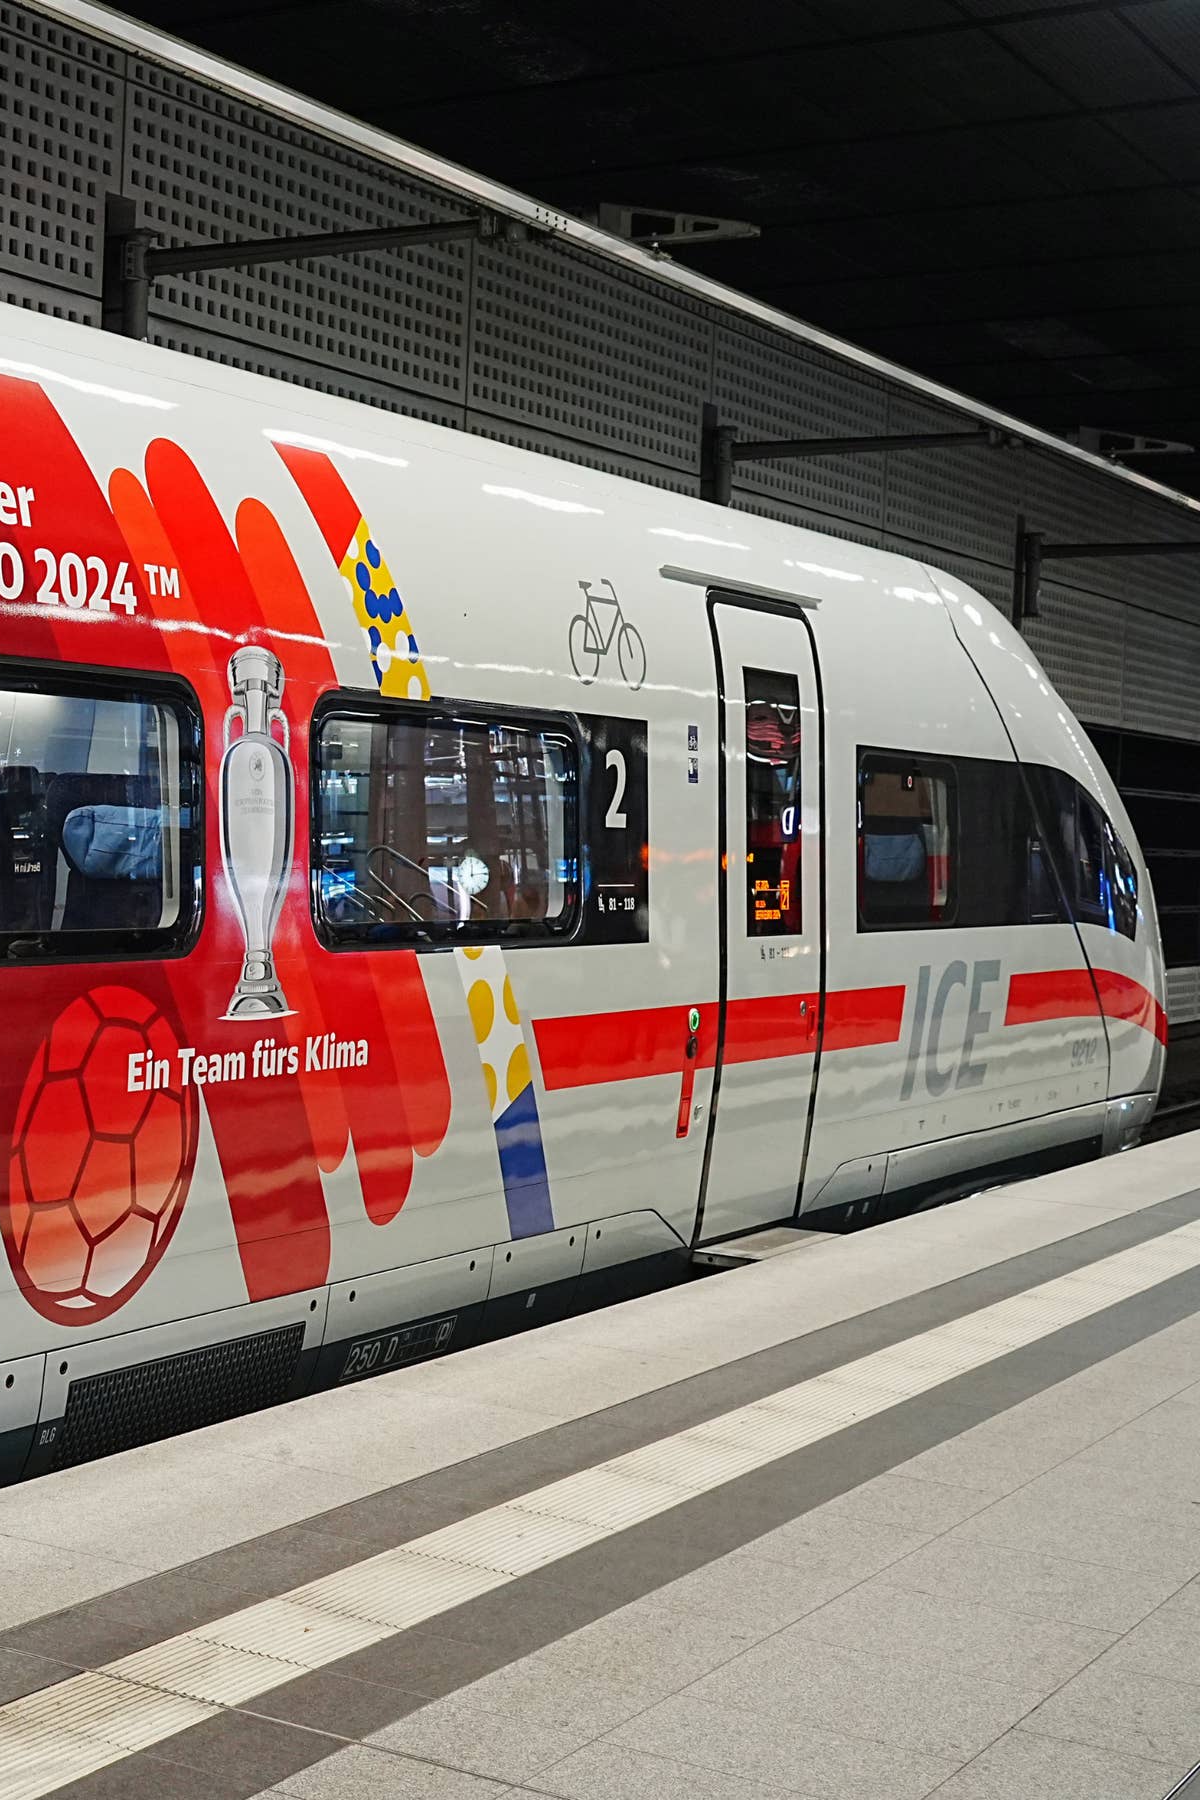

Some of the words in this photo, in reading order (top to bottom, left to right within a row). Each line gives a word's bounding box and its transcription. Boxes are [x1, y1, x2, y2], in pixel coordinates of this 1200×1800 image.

[34, 548, 138, 616] 2024
[605, 749, 627, 828] 2
[608, 897, 617, 911] 81
[127, 1049, 170, 1092] Ein
[177, 1047, 246, 1086] Team
[252, 1038, 299, 1078] fürs
[305, 1032, 368, 1072] Klima
[900, 960, 1001, 1101] ICE
[344, 1341, 381, 1375] 250
